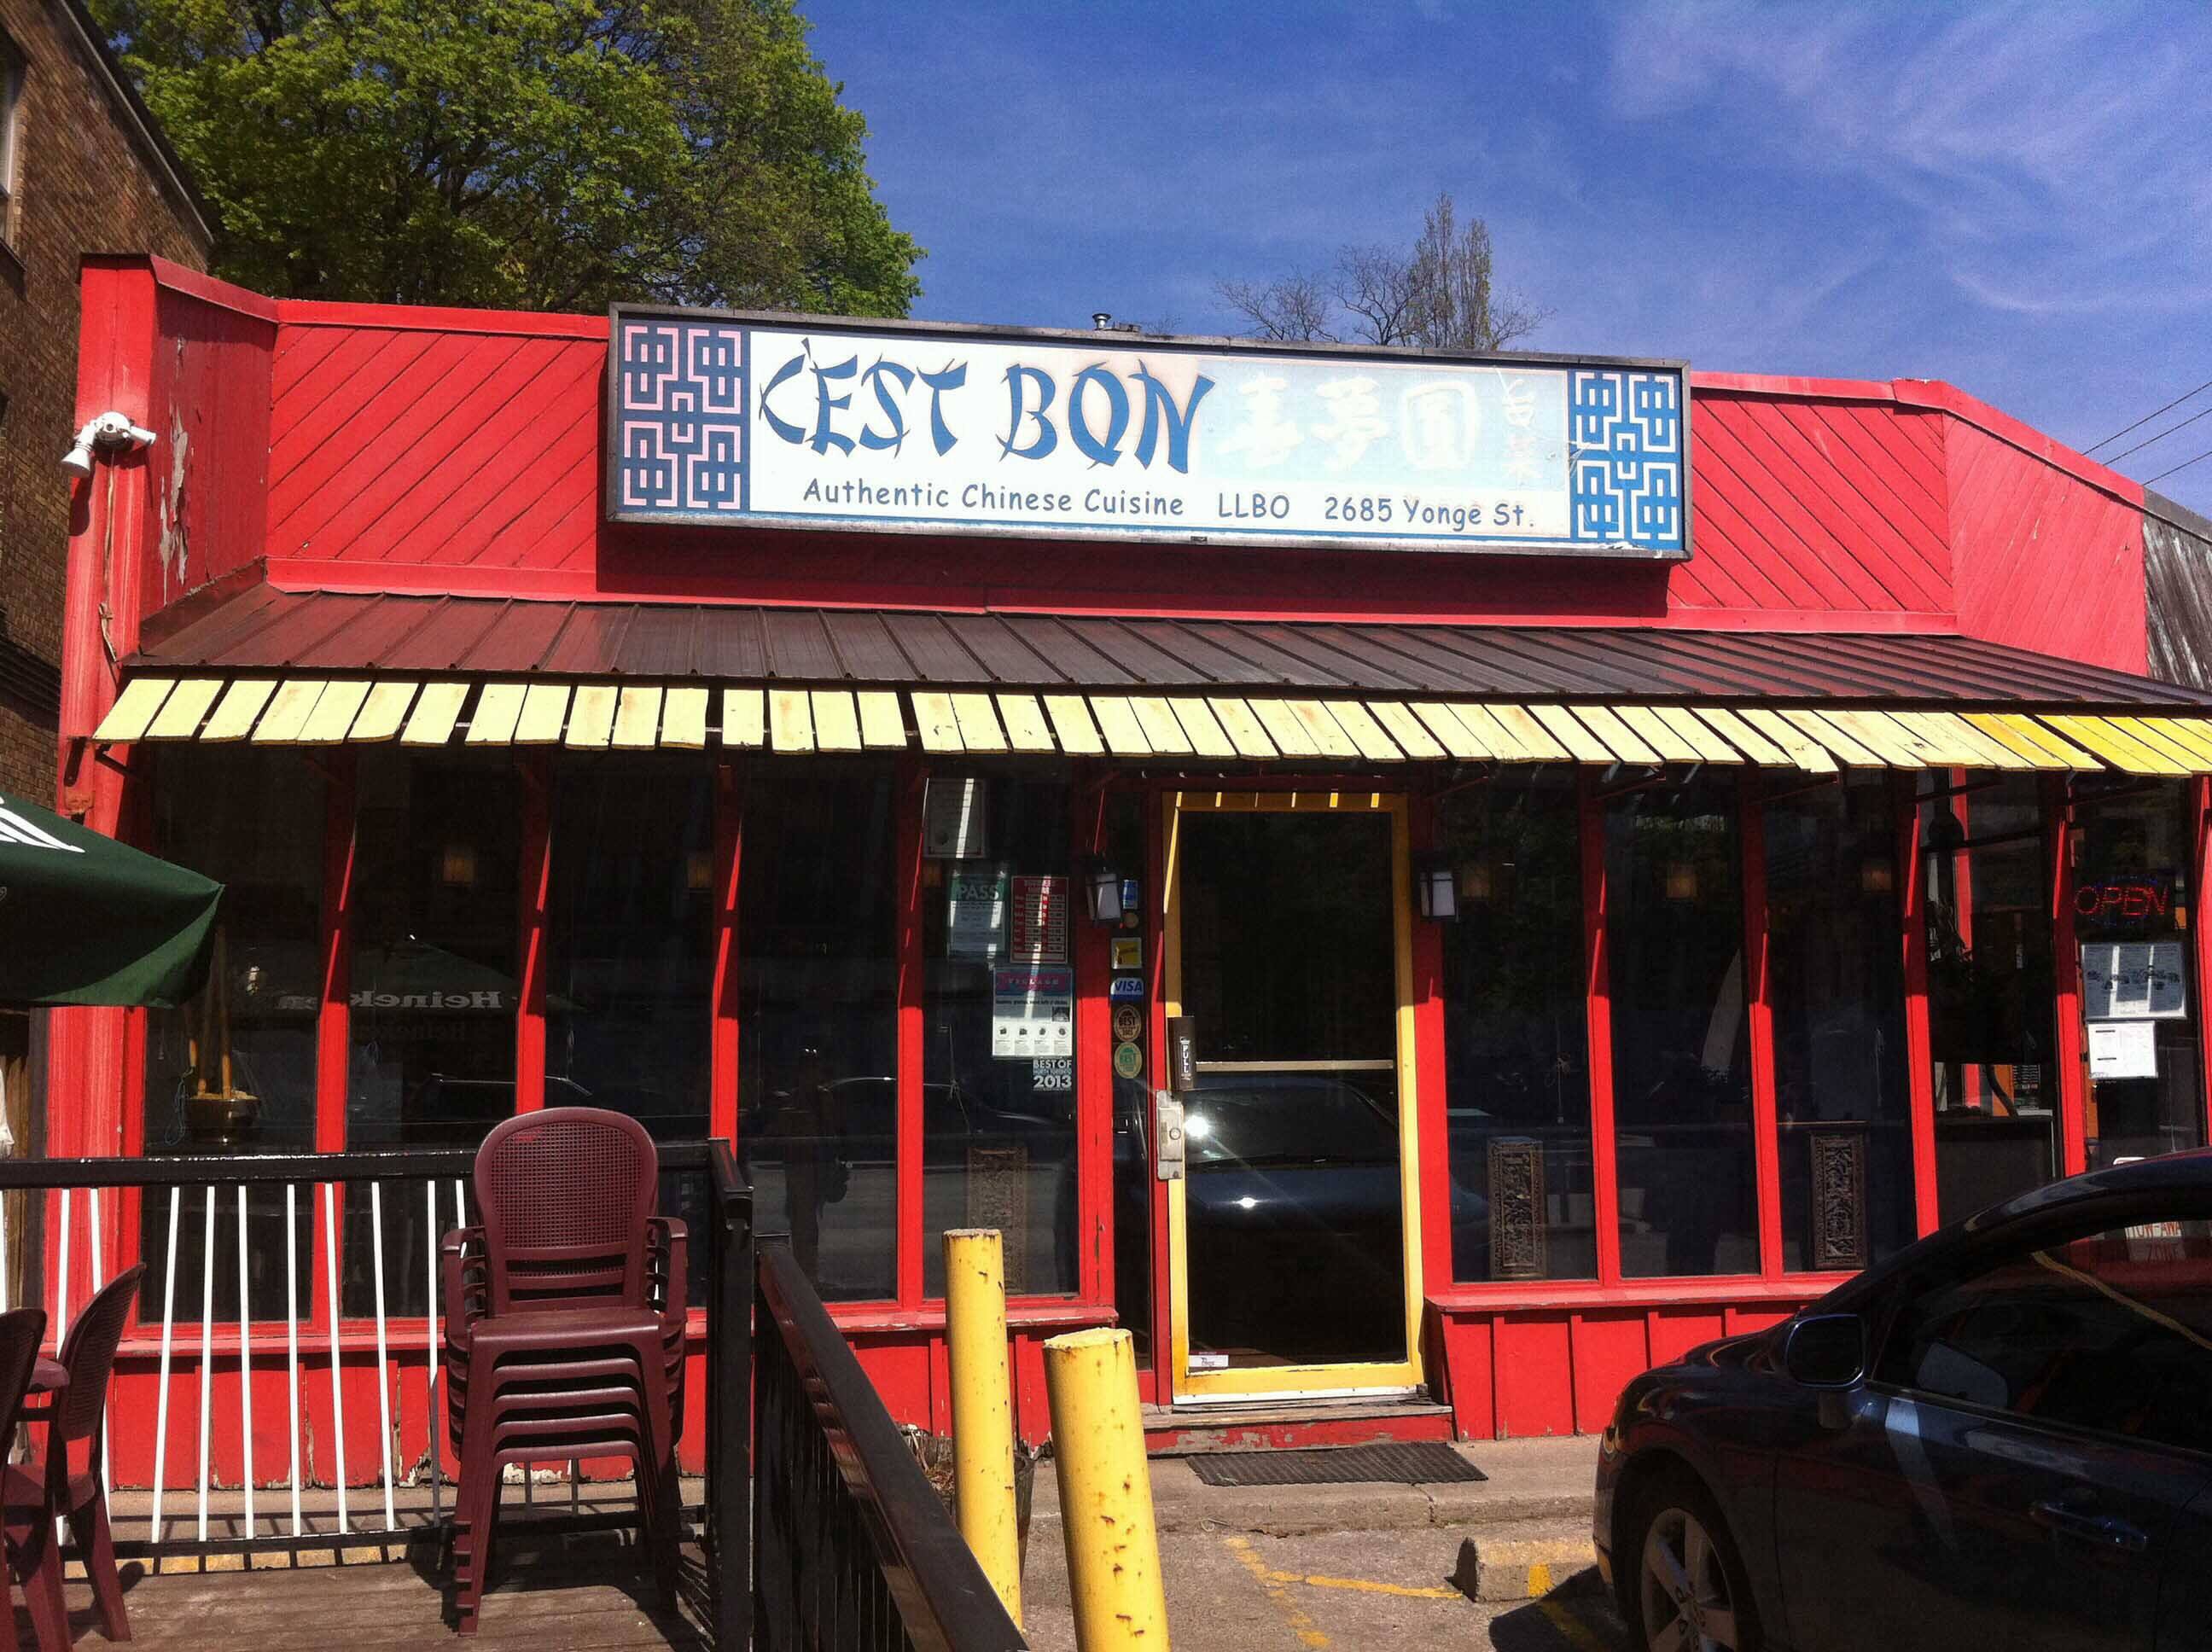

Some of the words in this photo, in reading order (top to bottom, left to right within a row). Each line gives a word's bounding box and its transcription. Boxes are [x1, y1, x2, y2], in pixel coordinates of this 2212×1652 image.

[995, 358, 1216, 474] BON
[803, 477, 949, 508] Authentic
[962, 482, 1072, 512] Chinese
[1085, 488, 1184, 516] Cuisine
[1218, 492, 1290, 519] LLBO
[1324, 497, 1393, 522] 2685
[1403, 499, 1481, 532] Yonge
[1493, 503, 1534, 528] St.
[958, 883, 1000, 900] PASS
[2074, 886, 2171, 916] OPEN
[1115, 980, 1143, 992] VISA
[1119, 1016, 1136, 1026] BEST
[1033, 1059, 1056, 1069] BEST
[1057, 1059, 1072, 1069] OF
[1033, 1074, 1072, 1089] 2013
